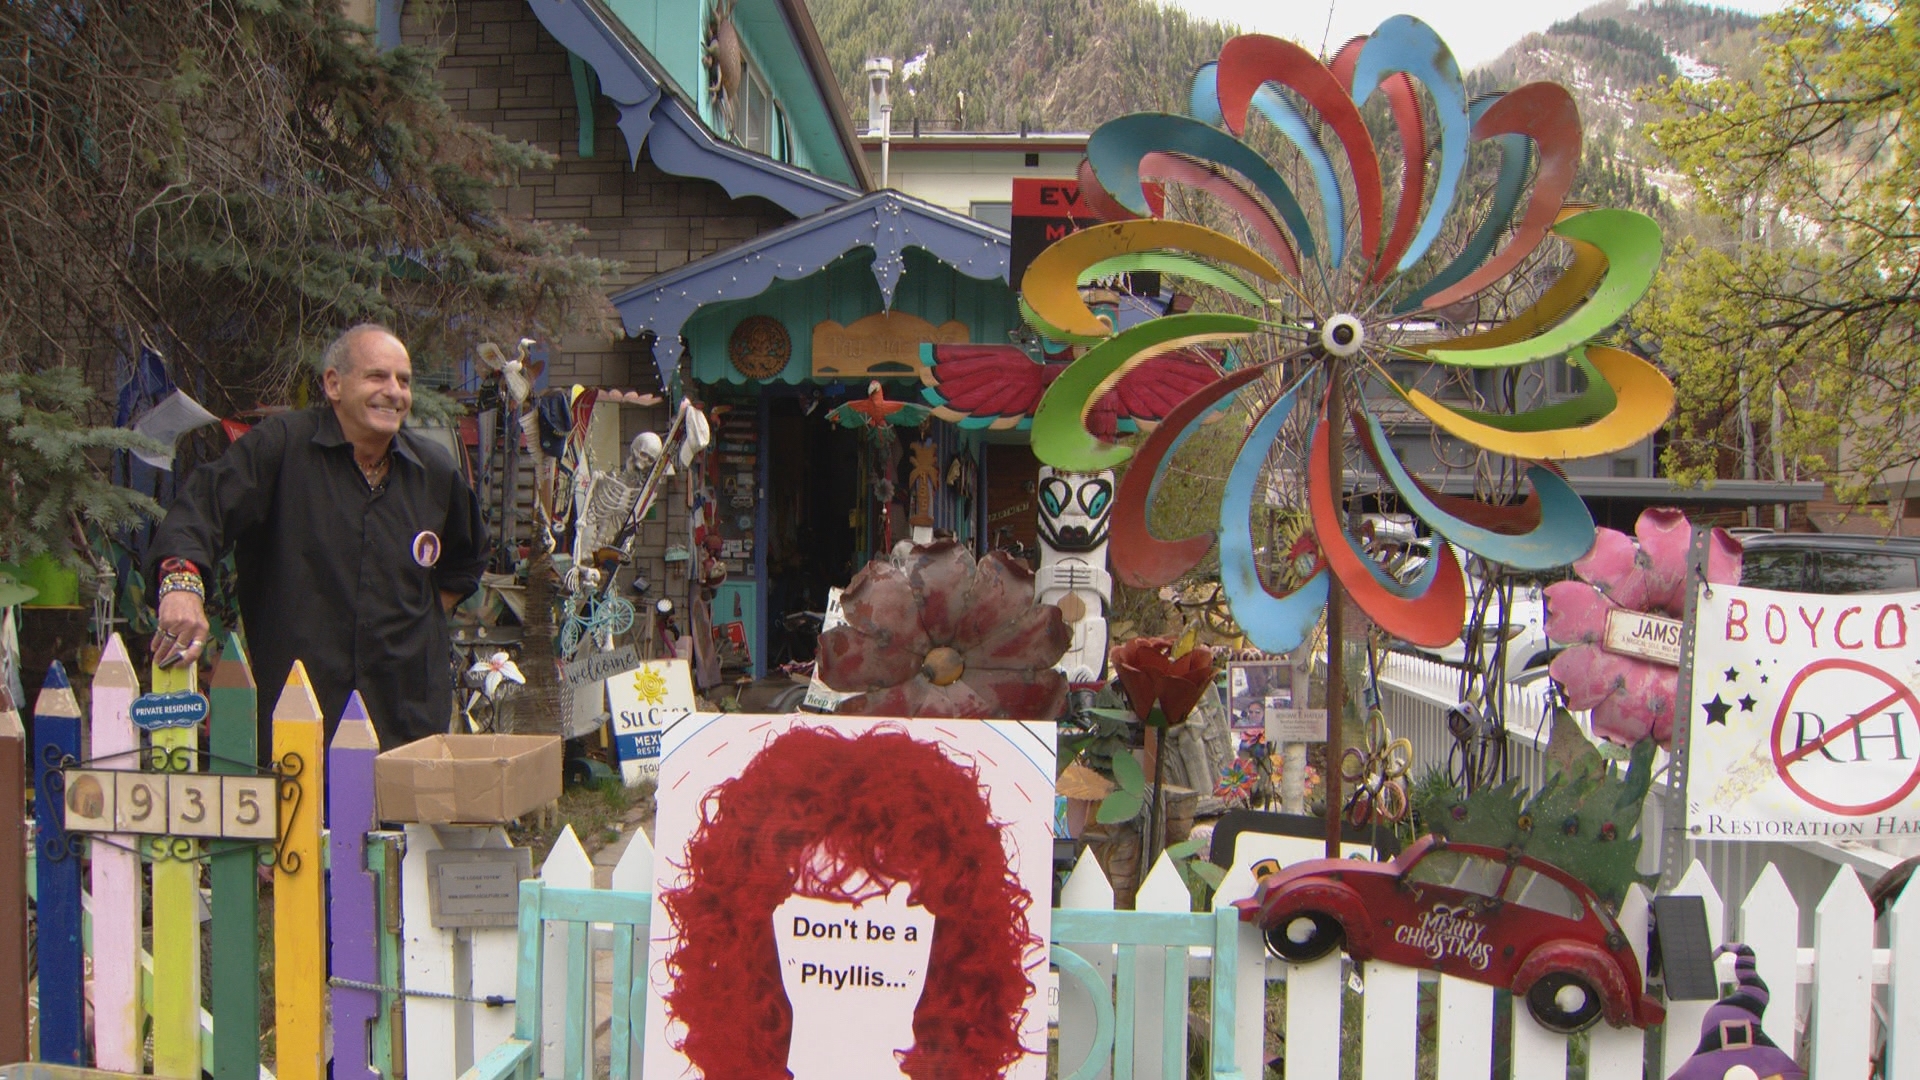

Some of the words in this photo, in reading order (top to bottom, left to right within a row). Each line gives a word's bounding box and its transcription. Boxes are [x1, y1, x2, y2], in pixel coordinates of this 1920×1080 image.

[1726, 598, 1920, 650] BOYCO
[569, 652, 635, 685] welcome
[136, 706, 163, 717] PRIVATE
[164, 703, 203, 714] RESIDENCE
[1792, 711, 1912, 763] RH
[1708, 814, 1864, 836] RESTORATION
[793, 916, 858, 940] Don't
[866, 920, 896, 941] be
[904, 925, 918, 942] a
[1418, 906, 1487, 940] MERRY
[1394, 924, 1494, 970] CHRISTMAS
